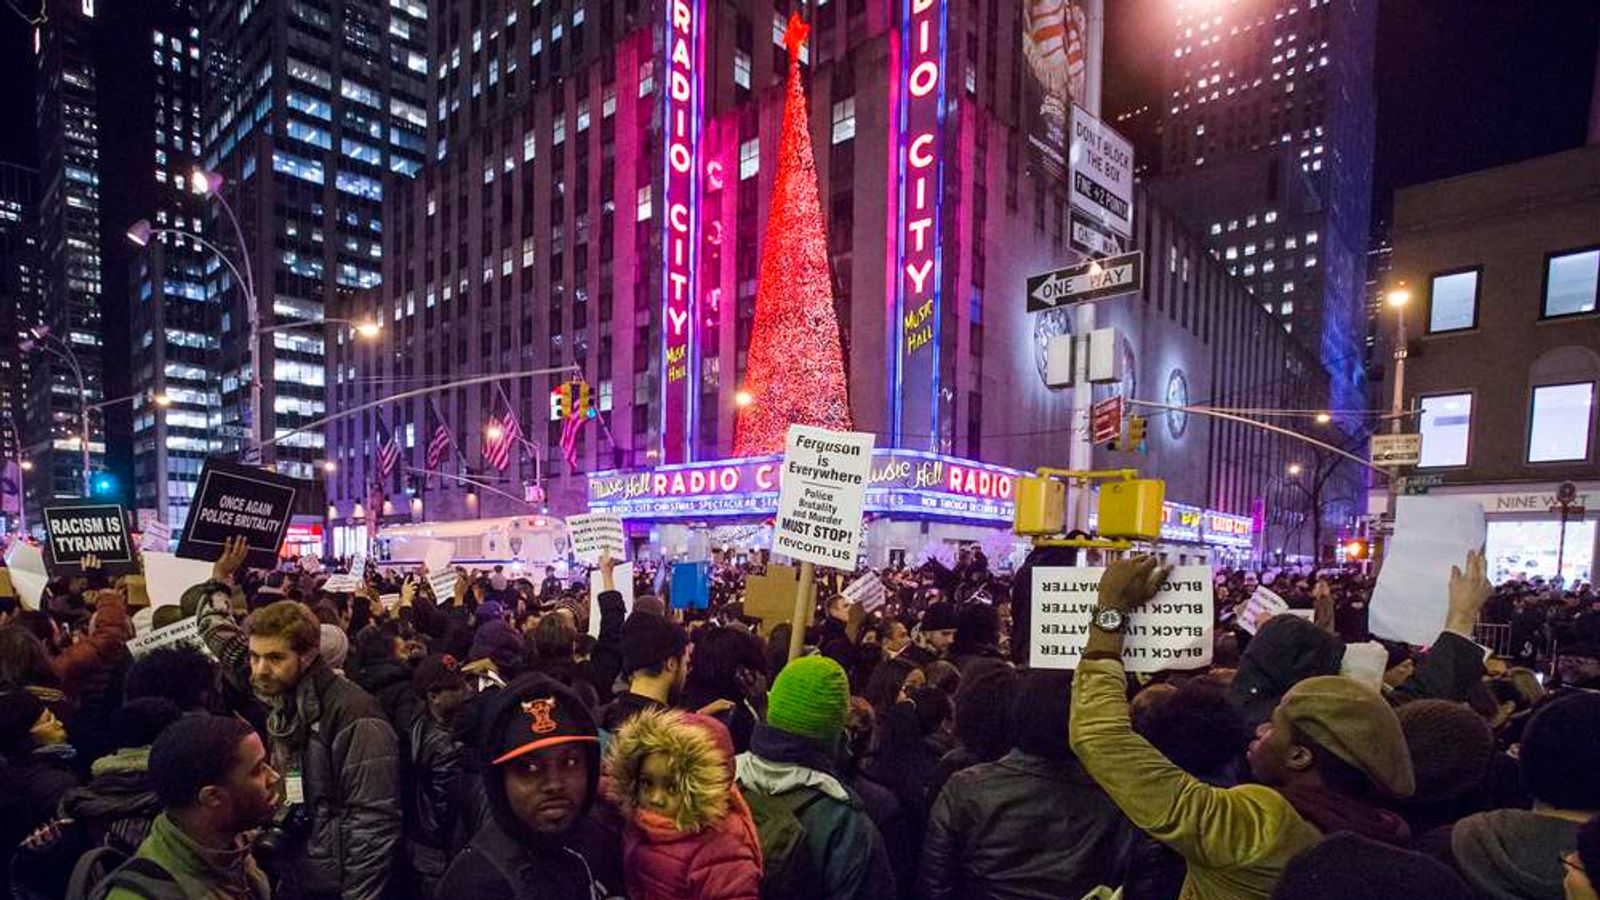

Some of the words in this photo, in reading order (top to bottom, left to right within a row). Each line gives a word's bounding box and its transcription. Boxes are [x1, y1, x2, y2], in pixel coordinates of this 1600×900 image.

[670, 0, 690, 172] RADIO
[1076, 121, 1102, 151] DON'T
[1104, 141, 1129, 170] BLOCK
[1087, 149, 1102, 173] THE
[1104, 161, 1120, 183] BOX
[906, 134, 934, 293] CITY
[1079, 226, 1095, 243] ONE
[669, 204, 688, 335] CITY
[1043, 279, 1073, 298] ONE
[1090, 267, 1126, 289] WAY
[796, 434, 860, 456] Ferguson
[817, 454, 829, 467] is
[654, 467, 738, 496] RADIO
[756, 464, 784, 489] CI
[789, 461, 862, 484] Everywhere
[868, 457, 911, 483] usic
[950, 466, 1012, 498] RADIO
[805, 488, 833, 501] Police
[1497, 495, 1537, 509] NINE
[219, 494, 245, 511] ONCE
[245, 500, 273, 516] AGAIN
[798, 498, 837, 515] Brutality
[51, 517, 104, 534] RACISM
[106, 516, 121, 533] IS
[200, 507, 235, 525] POLICE
[233, 514, 280, 533] BRUTALITY
[792, 509, 807, 518] and
[808, 511, 842, 525] Murder
[782, 517, 811, 536] MUST
[813, 524, 853, 544] STOP!
[55, 535, 121, 552] TYRANNY
[779, 535, 850, 560] revcom.us
[1160, 582, 1202, 592] BLAC
[1152, 603, 1203, 614] BLACK
[1041, 624, 1087, 635] ATTER
[1152, 626, 1203, 636] BLACK
[1041, 645, 1087, 656] ATTER
[1123, 647, 1147, 658] LIV
[1152, 647, 1203, 658] BLACK
